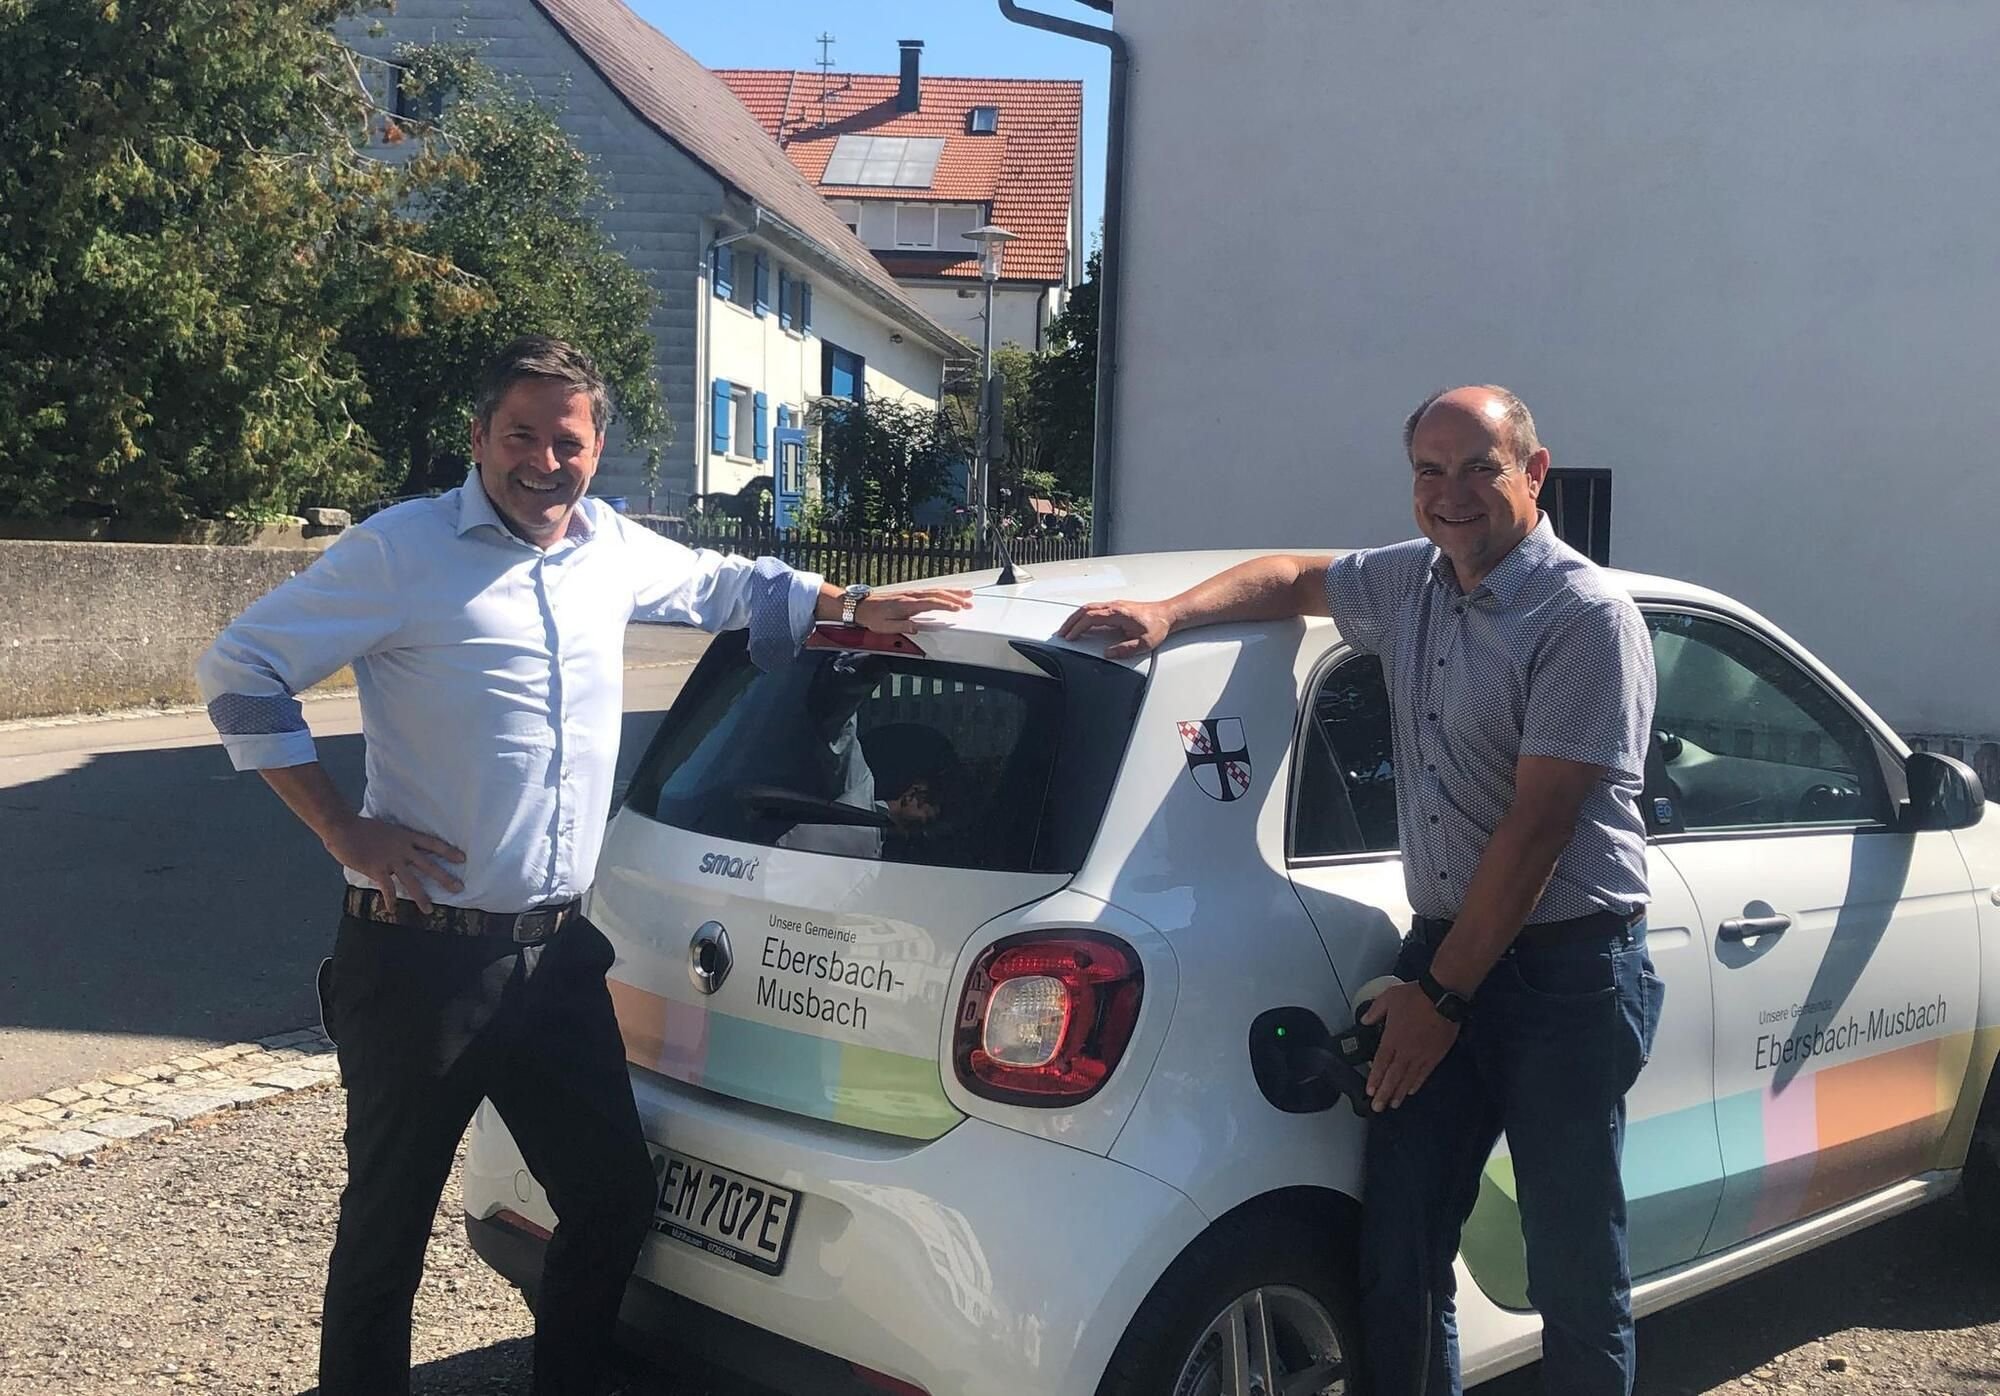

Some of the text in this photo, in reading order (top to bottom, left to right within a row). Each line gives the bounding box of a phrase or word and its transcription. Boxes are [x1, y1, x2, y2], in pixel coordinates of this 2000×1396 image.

[699, 852, 759, 881] smart
[768, 913, 857, 944] Unsere Gemeinde
[761, 936, 905, 993] Ebersbach-
[757, 975, 868, 1030] Musbach
[1759, 1000, 1833, 1024] Unsere Gemeinde
[1755, 994, 1947, 1070] Ebersbach-Musbach
[658, 1159, 787, 1253] EM 707E
